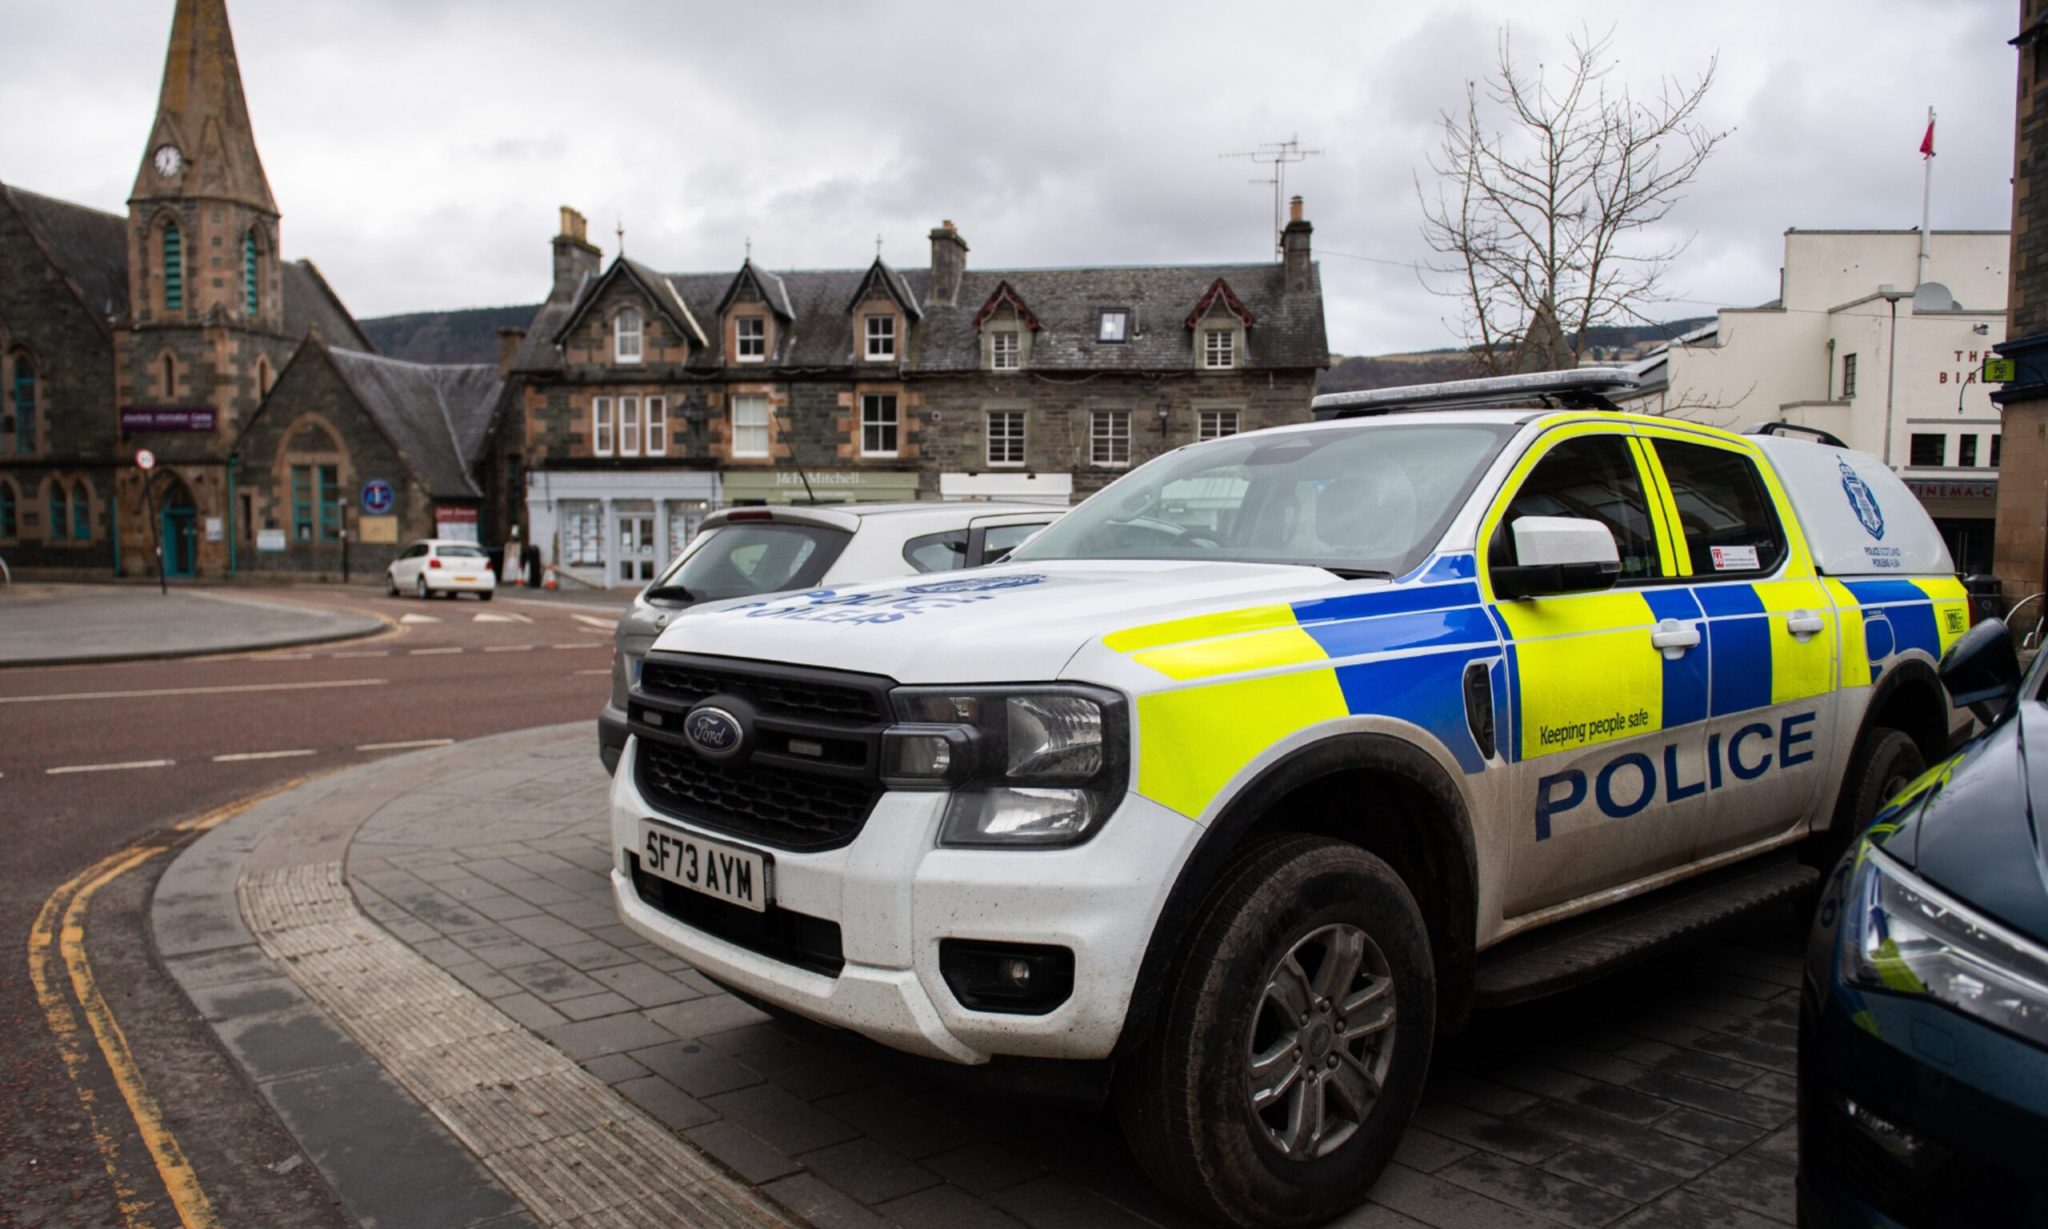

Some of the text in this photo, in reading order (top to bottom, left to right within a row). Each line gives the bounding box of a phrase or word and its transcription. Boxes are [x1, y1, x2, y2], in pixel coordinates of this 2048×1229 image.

[1954, 350, 1992, 362] THE
[1939, 372, 1994, 385] BIR
[809, 472, 860, 484] Mitchell
[694, 716, 726, 745] Ford
[1540, 708, 1649, 746] Keeping people safe
[1535, 711, 1816, 842] POLICE
[646, 830, 753, 902] SF73 AYM
